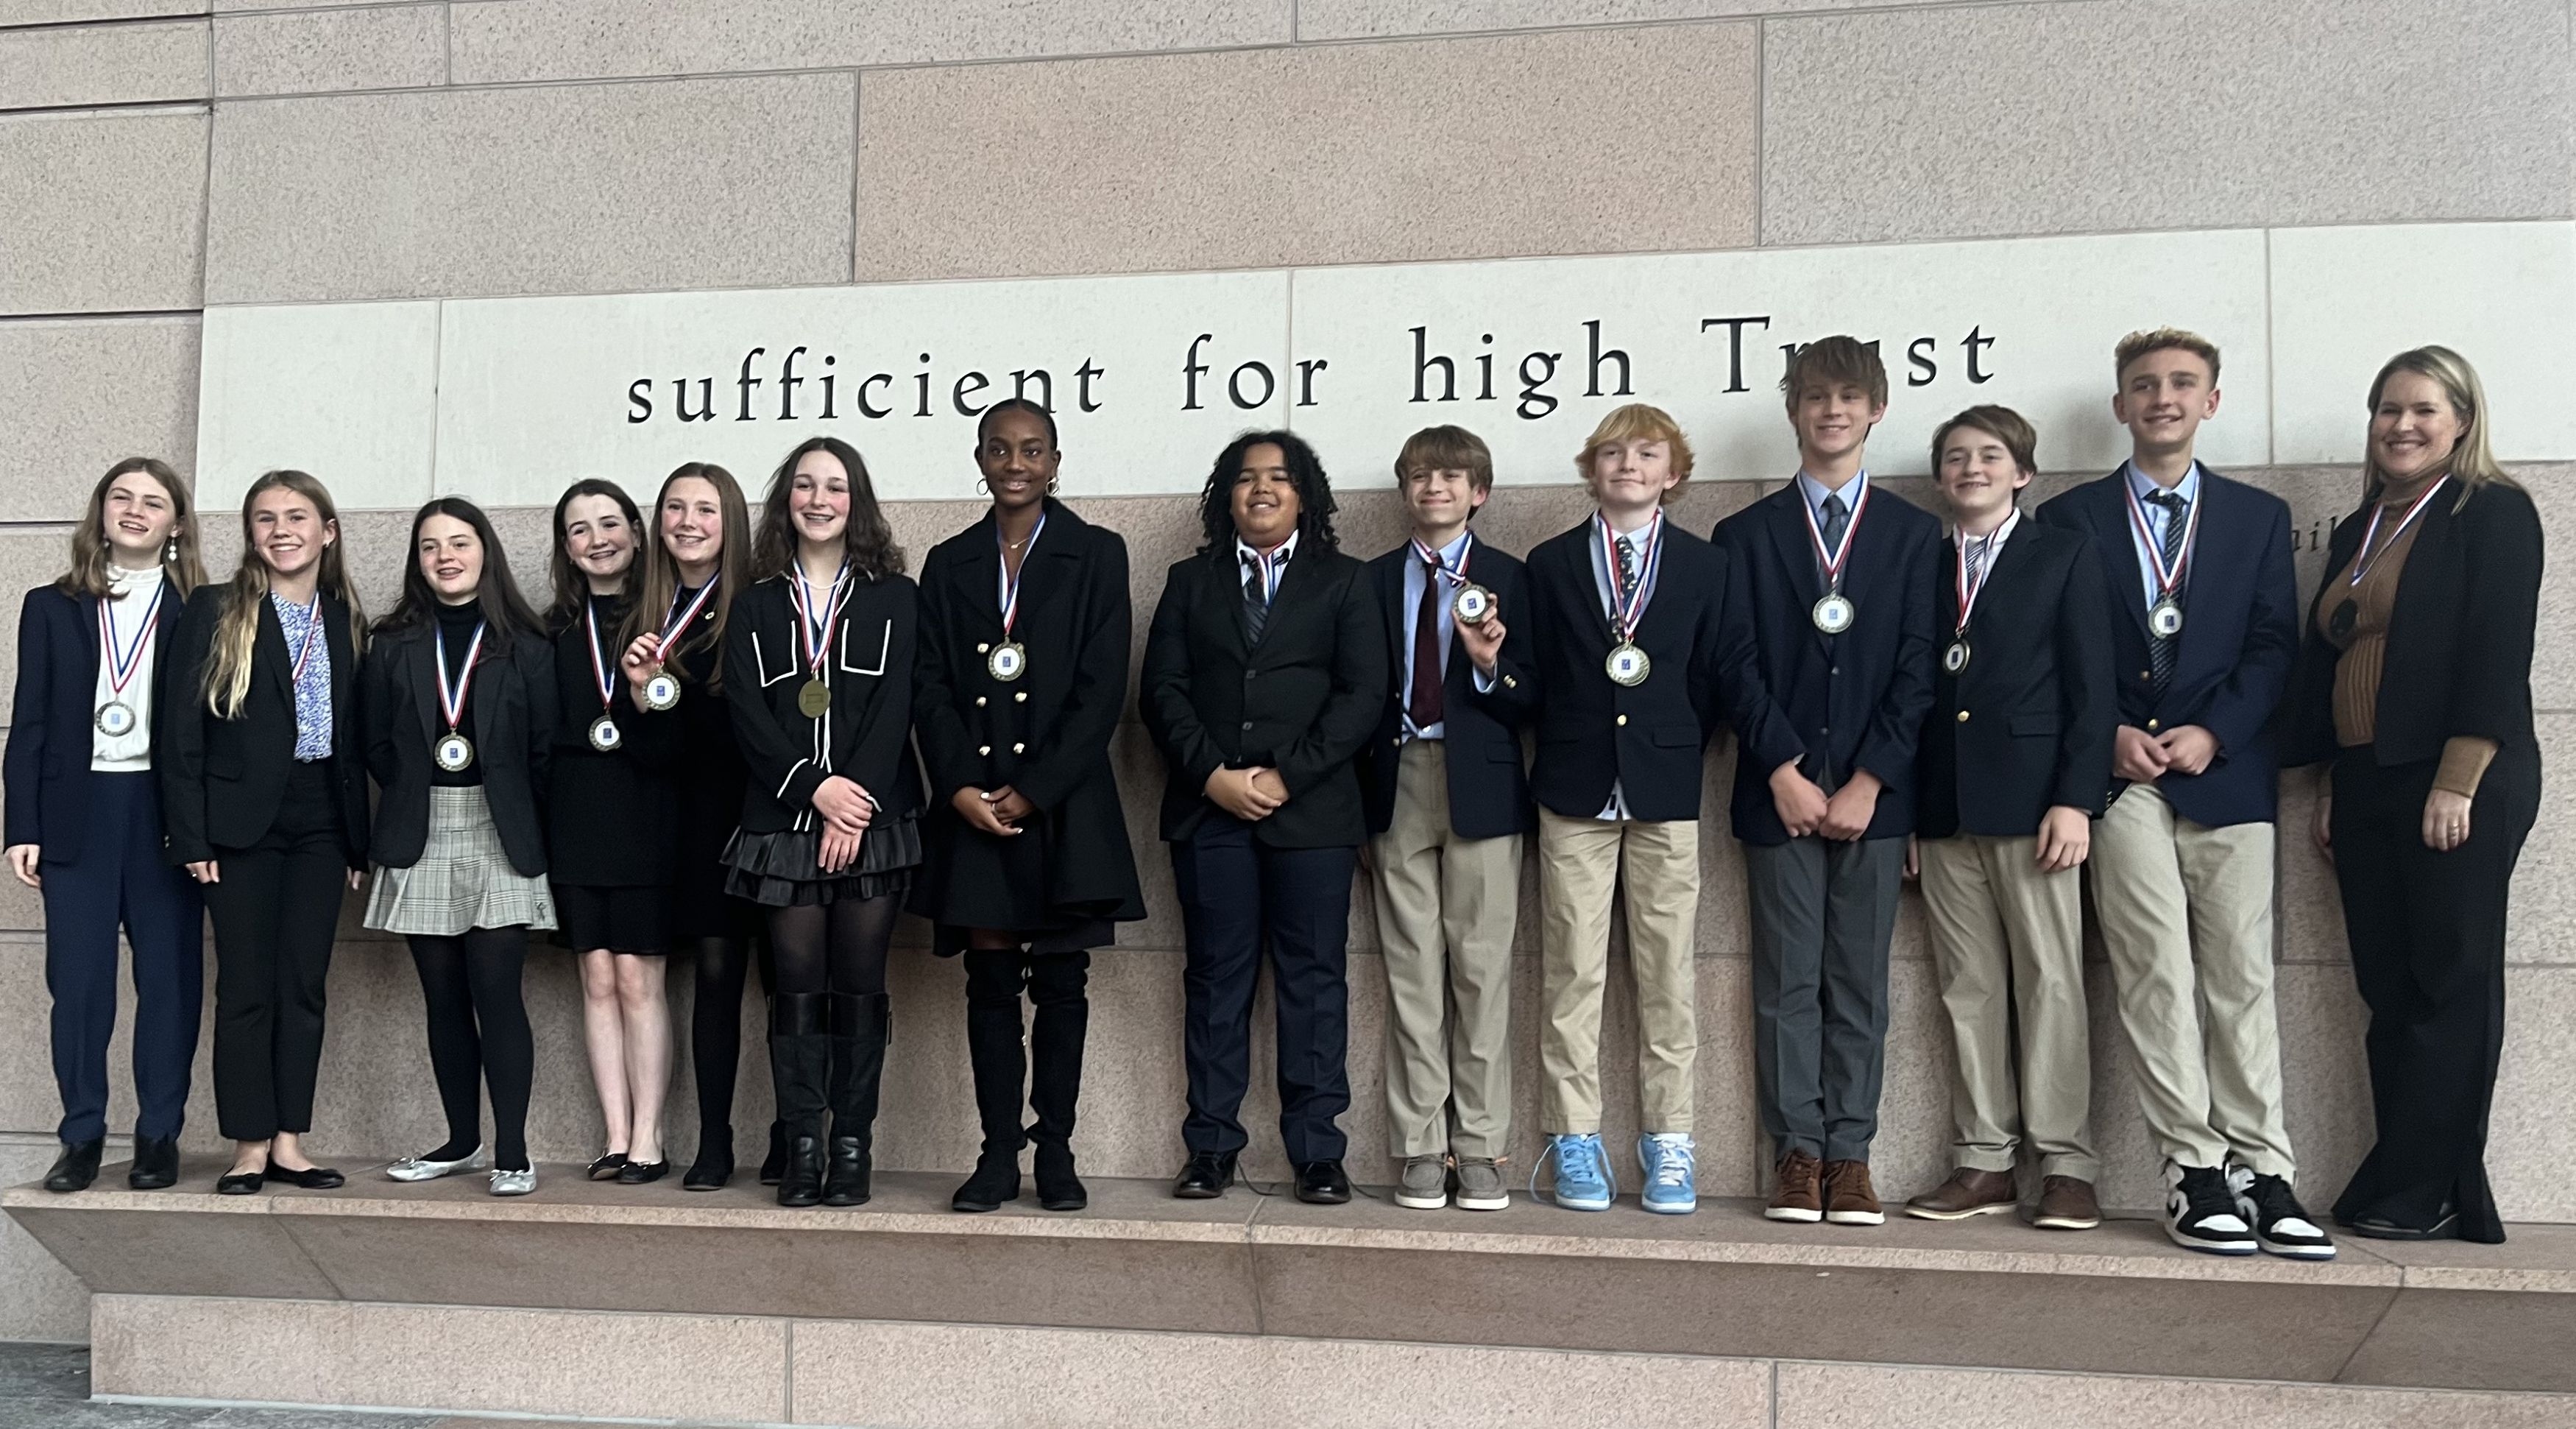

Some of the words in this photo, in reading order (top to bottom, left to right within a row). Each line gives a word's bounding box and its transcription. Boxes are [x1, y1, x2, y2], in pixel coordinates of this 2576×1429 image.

[628, 346, 1105, 424] sufficient
[1181, 334, 1328, 411] for
[1408, 320, 1635, 420] high
[1701, 316, 1996, 394] Trst
